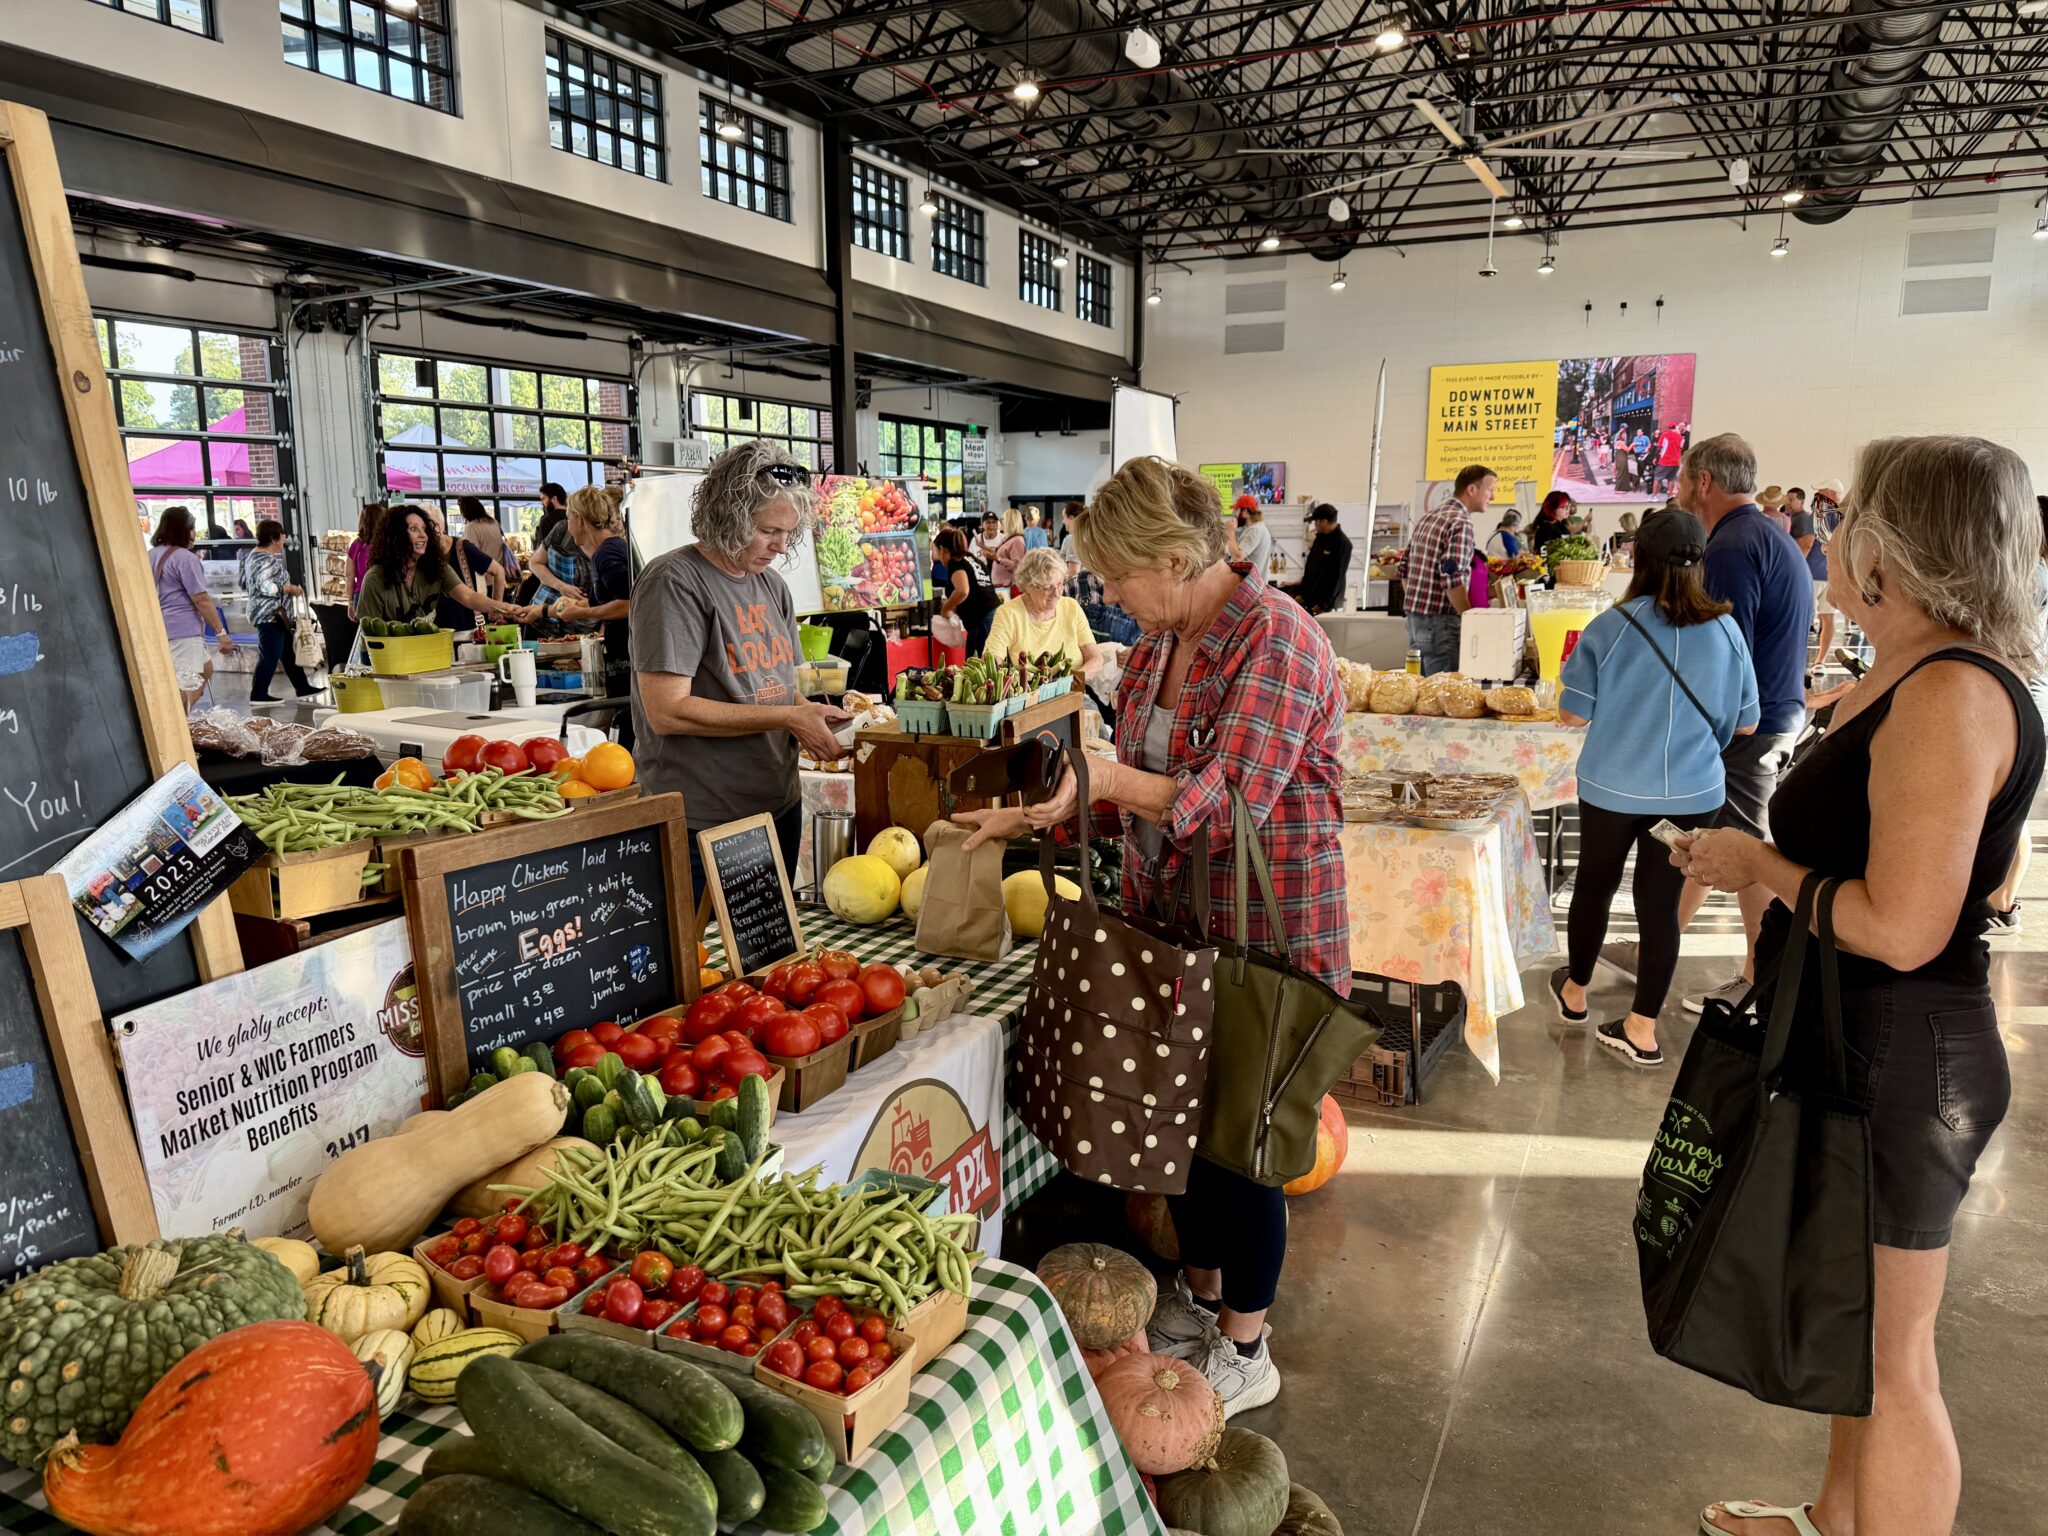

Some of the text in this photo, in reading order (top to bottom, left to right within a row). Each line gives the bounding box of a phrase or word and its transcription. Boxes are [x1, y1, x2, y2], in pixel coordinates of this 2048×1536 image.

[1441, 402, 1542, 418] LEE'S SUMMIT
[1449, 388, 1535, 403] DOWNTOWN
[1443, 418, 1538, 433] MAIN STREET
[965, 443, 985, 451] Meat
[1494, 464, 1532, 472] dedicated
[8, 477, 28, 502] 10
[446, 483, 479, 492] LOCALLY
[510, 484, 526, 493] CBD
[4, 780, 87, 833] You!
[144, 855, 194, 902] 2025
[145, 850, 218, 916] MISSOURI STATE FAIR
[453, 838, 652, 911] Happy Chickens laid these
[152, 910, 166, 923] Thank
[181, 876, 204, 898] supporting
[456, 919, 507, 945] brown,
[511, 908, 545, 928] blue,
[546, 894, 585, 918] green,
[598, 872, 635, 894] white
[518, 915, 584, 963] Eggs!
[471, 948, 498, 974] Range
[589, 965, 619, 985] large
[467, 949, 582, 1011] price per dozen
[590, 981, 626, 1010] jumbo
[197, 997, 328, 1061] We gladly accept:
[470, 1003, 515, 1033] small
[475, 1029, 527, 1056] medium
[176, 1022, 356, 1116] Senior & WIC Farmers
[160, 1042, 379, 1159] Market Nutrition Program
[246, 1102, 318, 1152] Benefits
[1697, 1113, 1714, 1135] SUMMIT
[1655, 1129, 1724, 1169] armers
[212, 1205, 247, 1231] Farmer
[268, 1175, 303, 1200] number
[14, 1245, 42, 1267] OR
